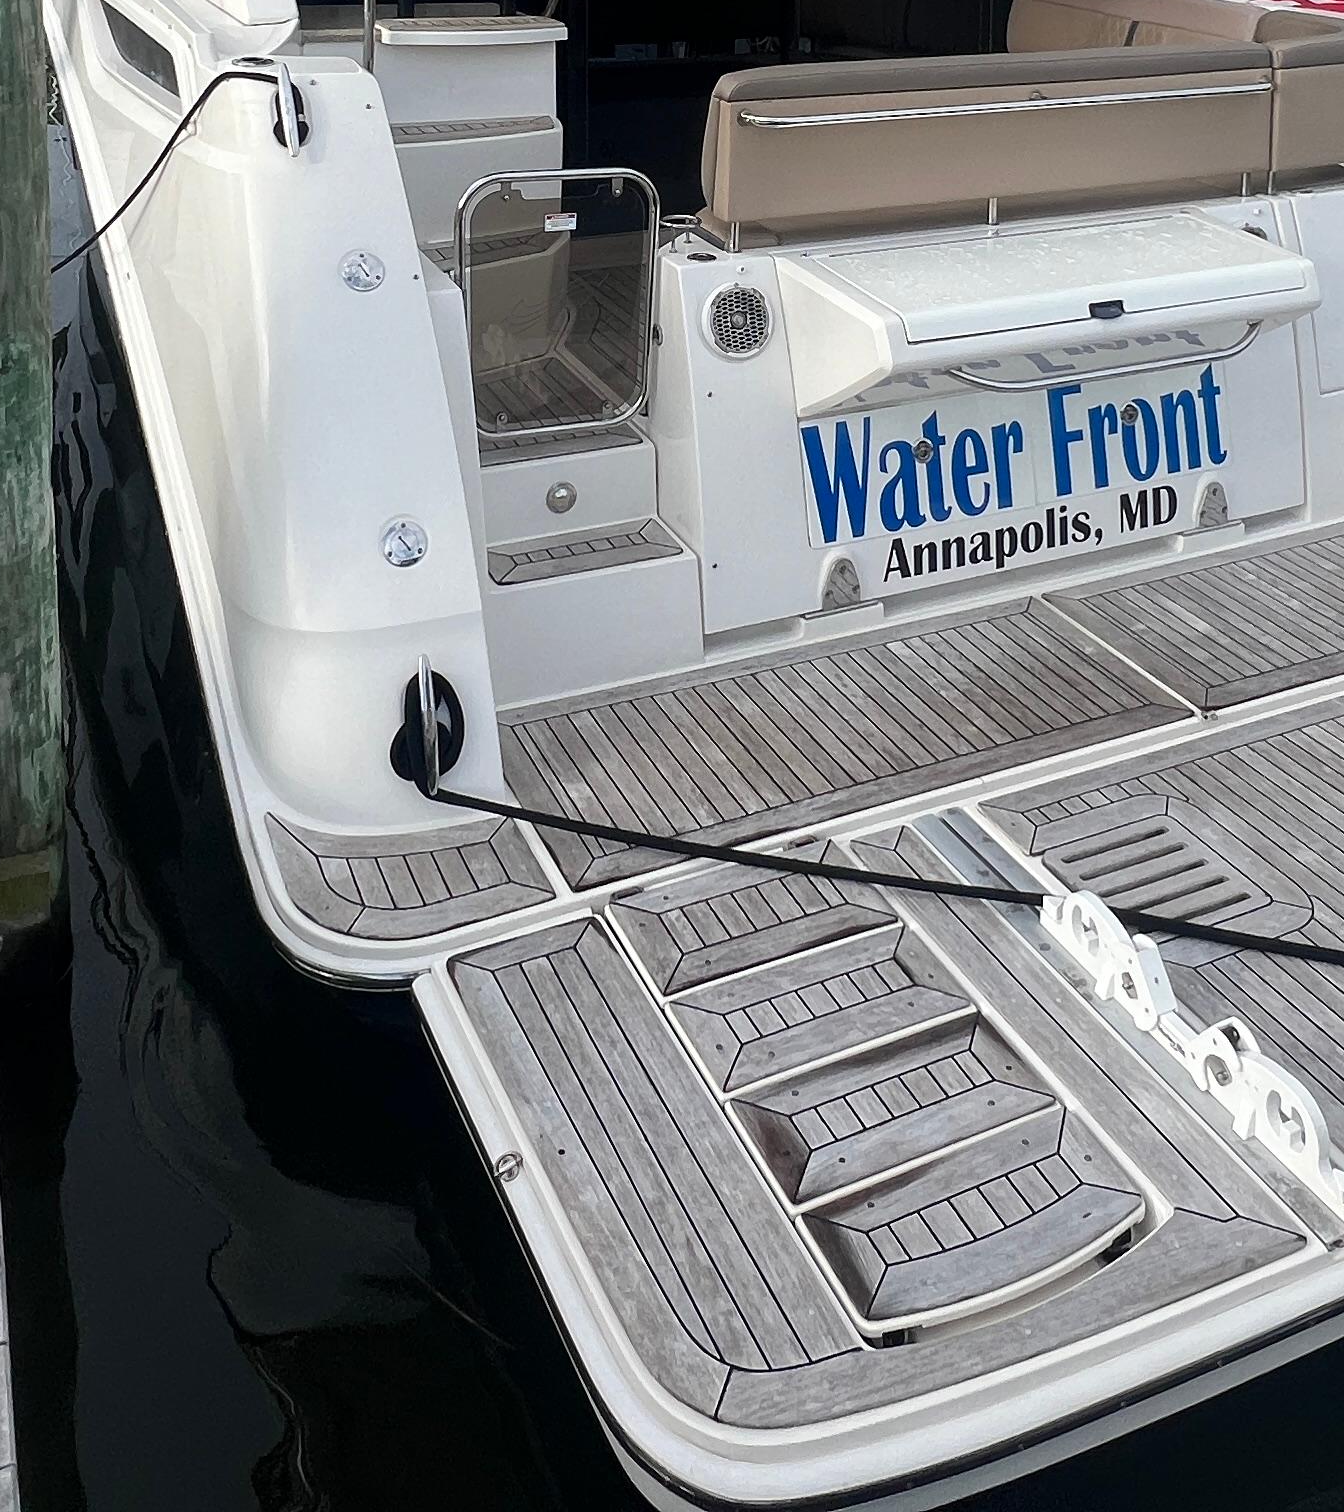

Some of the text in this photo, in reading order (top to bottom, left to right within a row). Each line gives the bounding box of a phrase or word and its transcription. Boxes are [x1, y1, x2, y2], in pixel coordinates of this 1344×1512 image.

[800, 362, 1228, 544] Water Front
[883, 484, 1178, 583] Annapolis, MD
